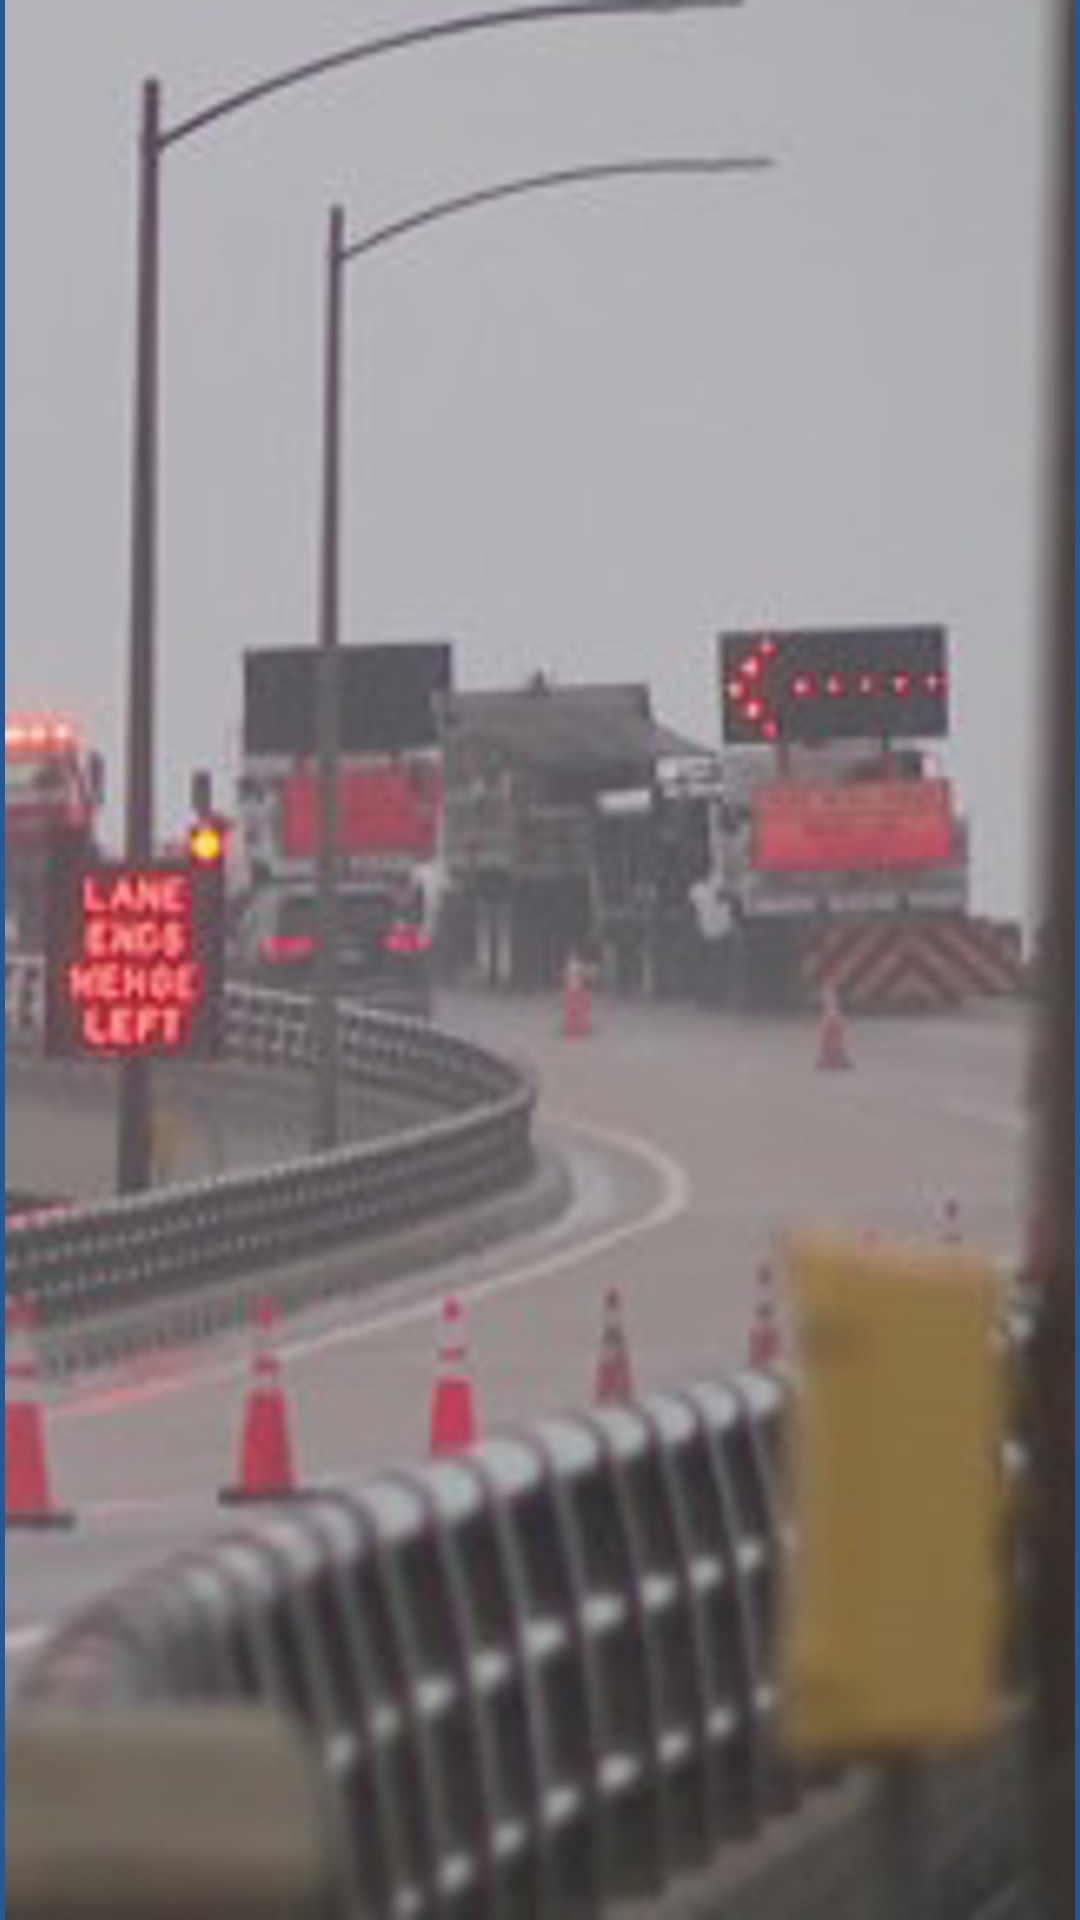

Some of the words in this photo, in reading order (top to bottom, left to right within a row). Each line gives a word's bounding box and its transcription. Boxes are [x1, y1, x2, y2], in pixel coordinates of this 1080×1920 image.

[82, 875, 187, 913] LANE
[84, 921, 186, 959] ENDS
[69, 963, 199, 1000] MERGE
[83, 1006, 181, 1046] LEFT
